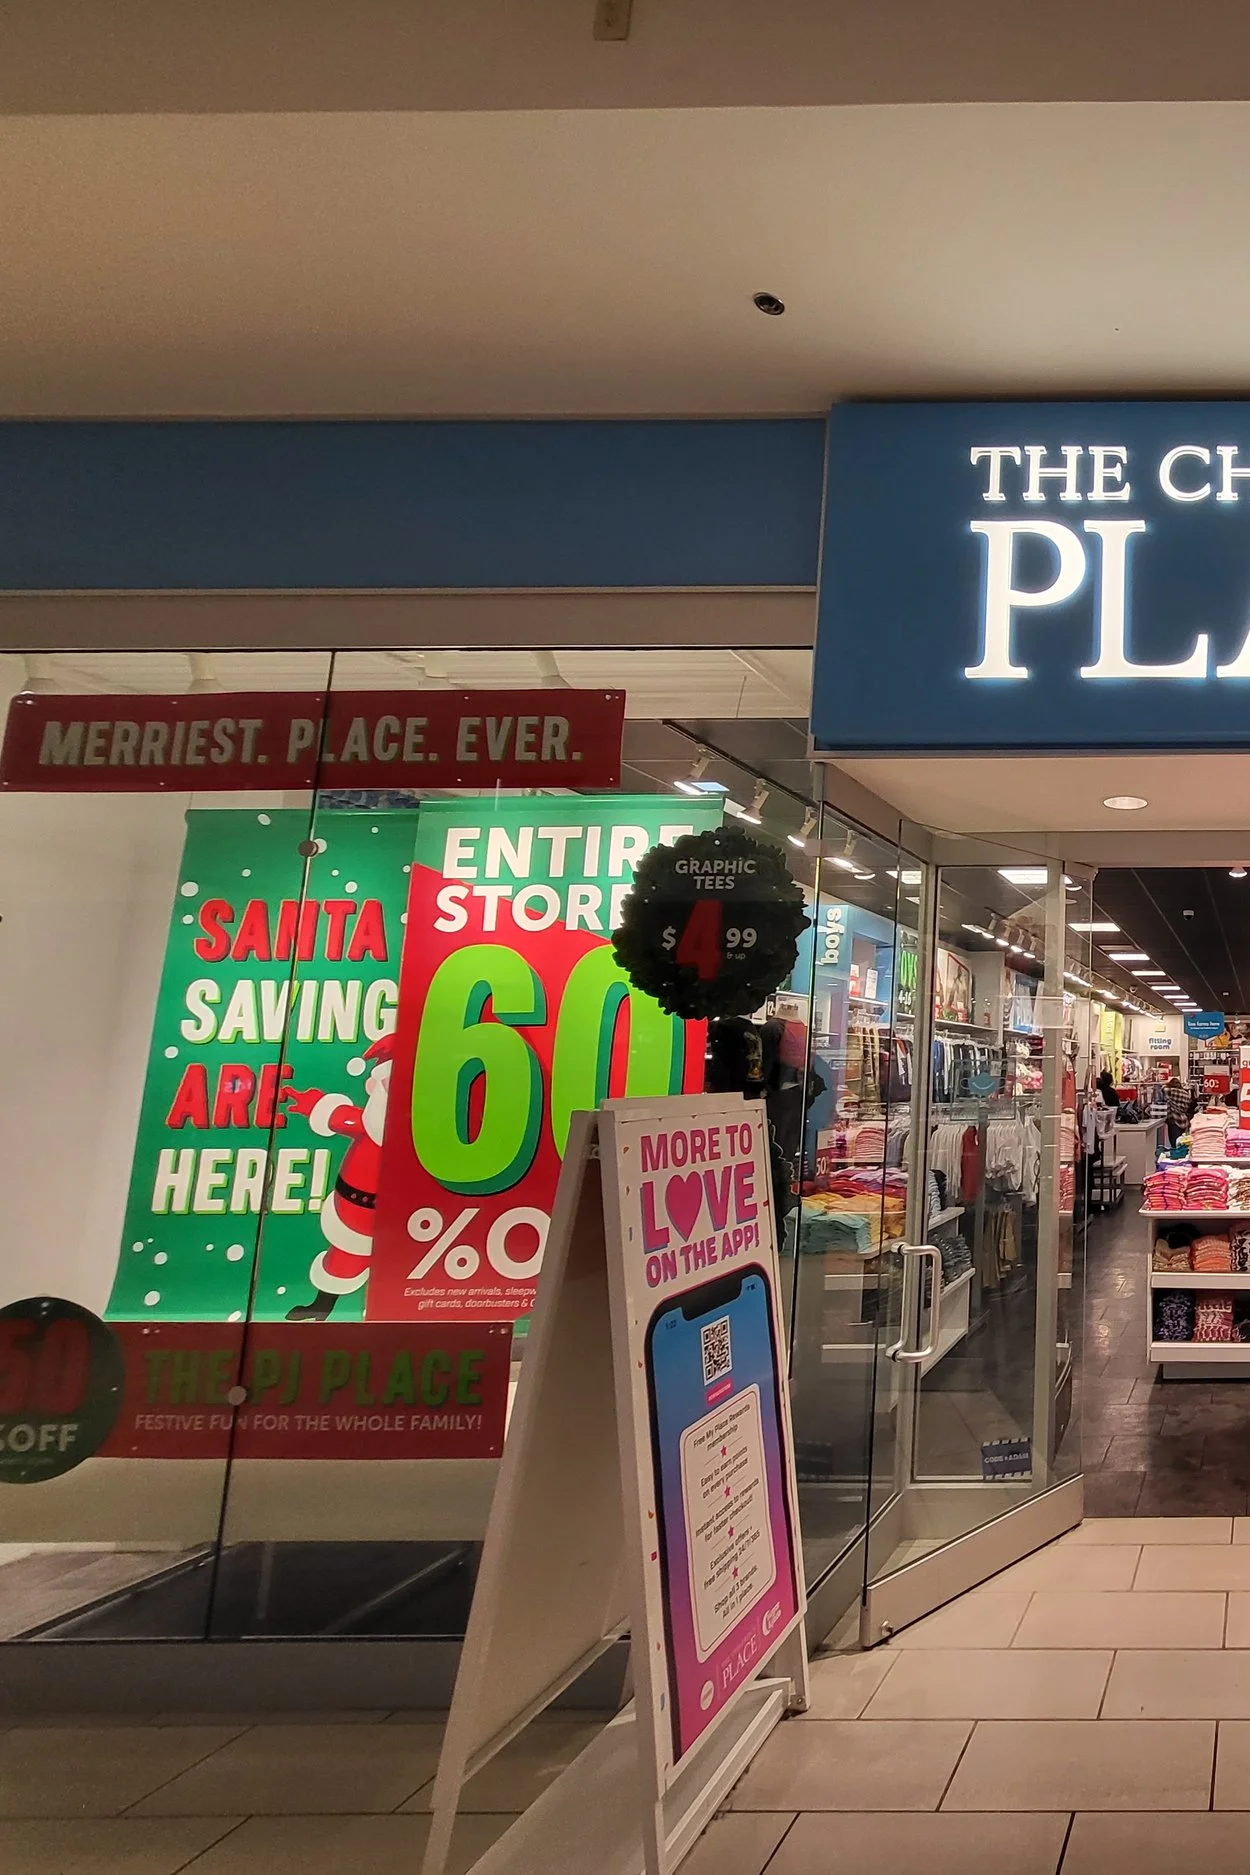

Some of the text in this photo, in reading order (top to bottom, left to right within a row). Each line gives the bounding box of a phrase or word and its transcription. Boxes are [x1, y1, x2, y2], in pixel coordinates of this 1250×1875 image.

[970, 444, 1131, 504] THE
[39, 715, 583, 766] MERRIEST. PLACE. EVER.
[442, 825, 694, 879] ENTIR
[675, 859, 757, 875] GRAPHIC
[693, 875, 736, 891] TEES
[193, 898, 388, 962] SANTA
[180, 978, 400, 1044] SAVING
[165, 1063, 294, 1130] ARE
[641, 1123, 752, 1173] MORE TO
[151, 1148, 332, 1215] HERE!
[406, 1206, 552, 1281] %O
[646, 1222, 760, 1288] ON THE APP!
[404, 1287, 446, 1297] Excludes
[447, 1289, 466, 1297] new
[505, 1286, 537, 1298] sleepw
[418, 1299, 434, 1312] gift
[465, 1298, 520, 1309] doorbusters
[145, 1348, 486, 1408] THE PJ PLACE
[0, 1423, 79, 1453] OFF
[135, 1413, 483, 1432] FESTIVE FUN FOR THE WHOLE FAMILY!
[693, 1435, 706, 1449] Free
[705, 1428, 715, 1440] My
[714, 1418, 729, 1434] Place
[700, 1472, 714, 1488] Easy
[720, 1458, 732, 1471] earn
[984, 1455, 1004, 1464] CODE
[702, 1489, 710, 1499] on
[710, 1477, 725, 1493] every
[709, 1543, 735, 1570] Exclusive
[714, 1596, 728, 1613] Shop
[722, 1633, 758, 1689] PLACE
